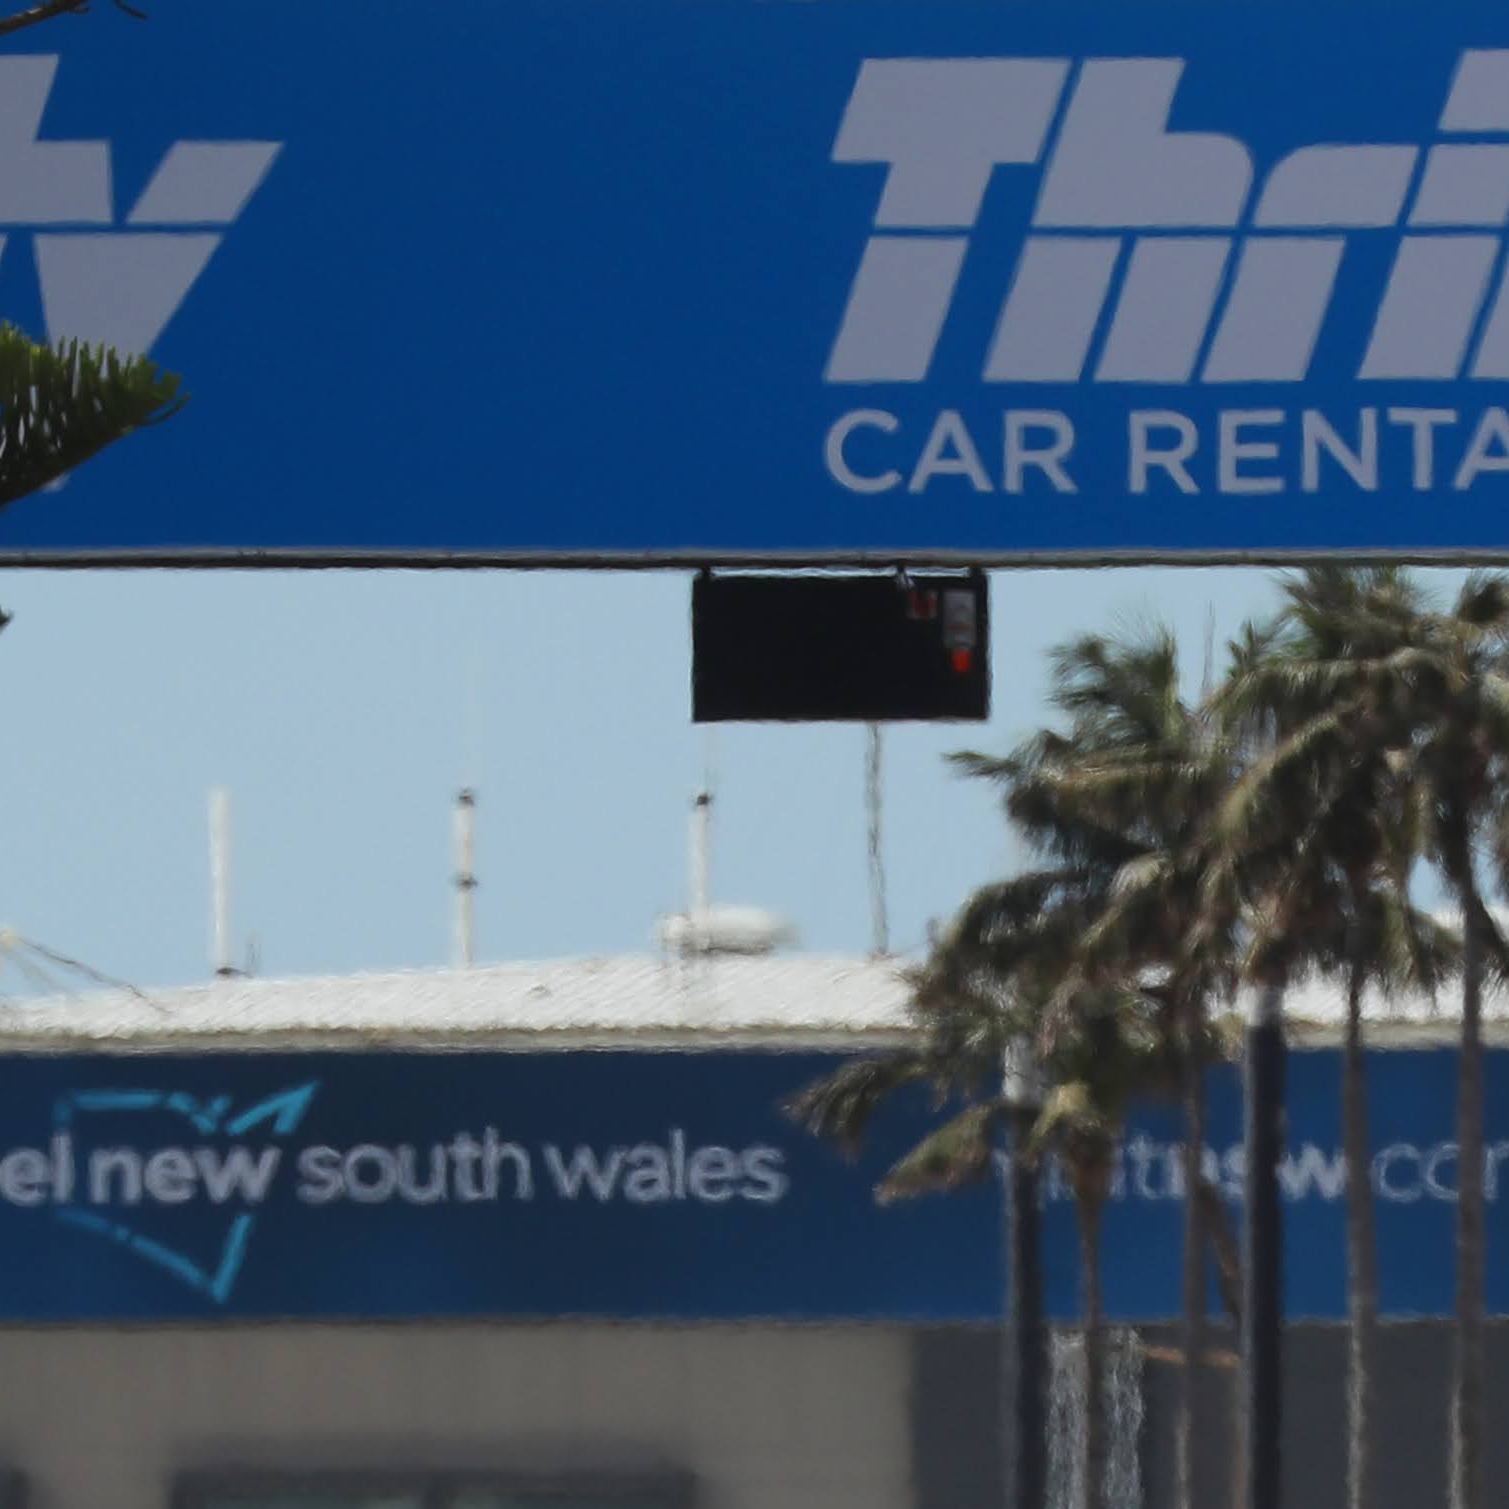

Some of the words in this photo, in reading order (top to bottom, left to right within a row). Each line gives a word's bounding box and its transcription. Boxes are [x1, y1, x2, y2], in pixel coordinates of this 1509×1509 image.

[825, 410, 1077, 493] CAR
[89, 1143, 280, 1203] new
[297, 1127, 532, 1203] south
[545, 1127, 787, 1203] wales
